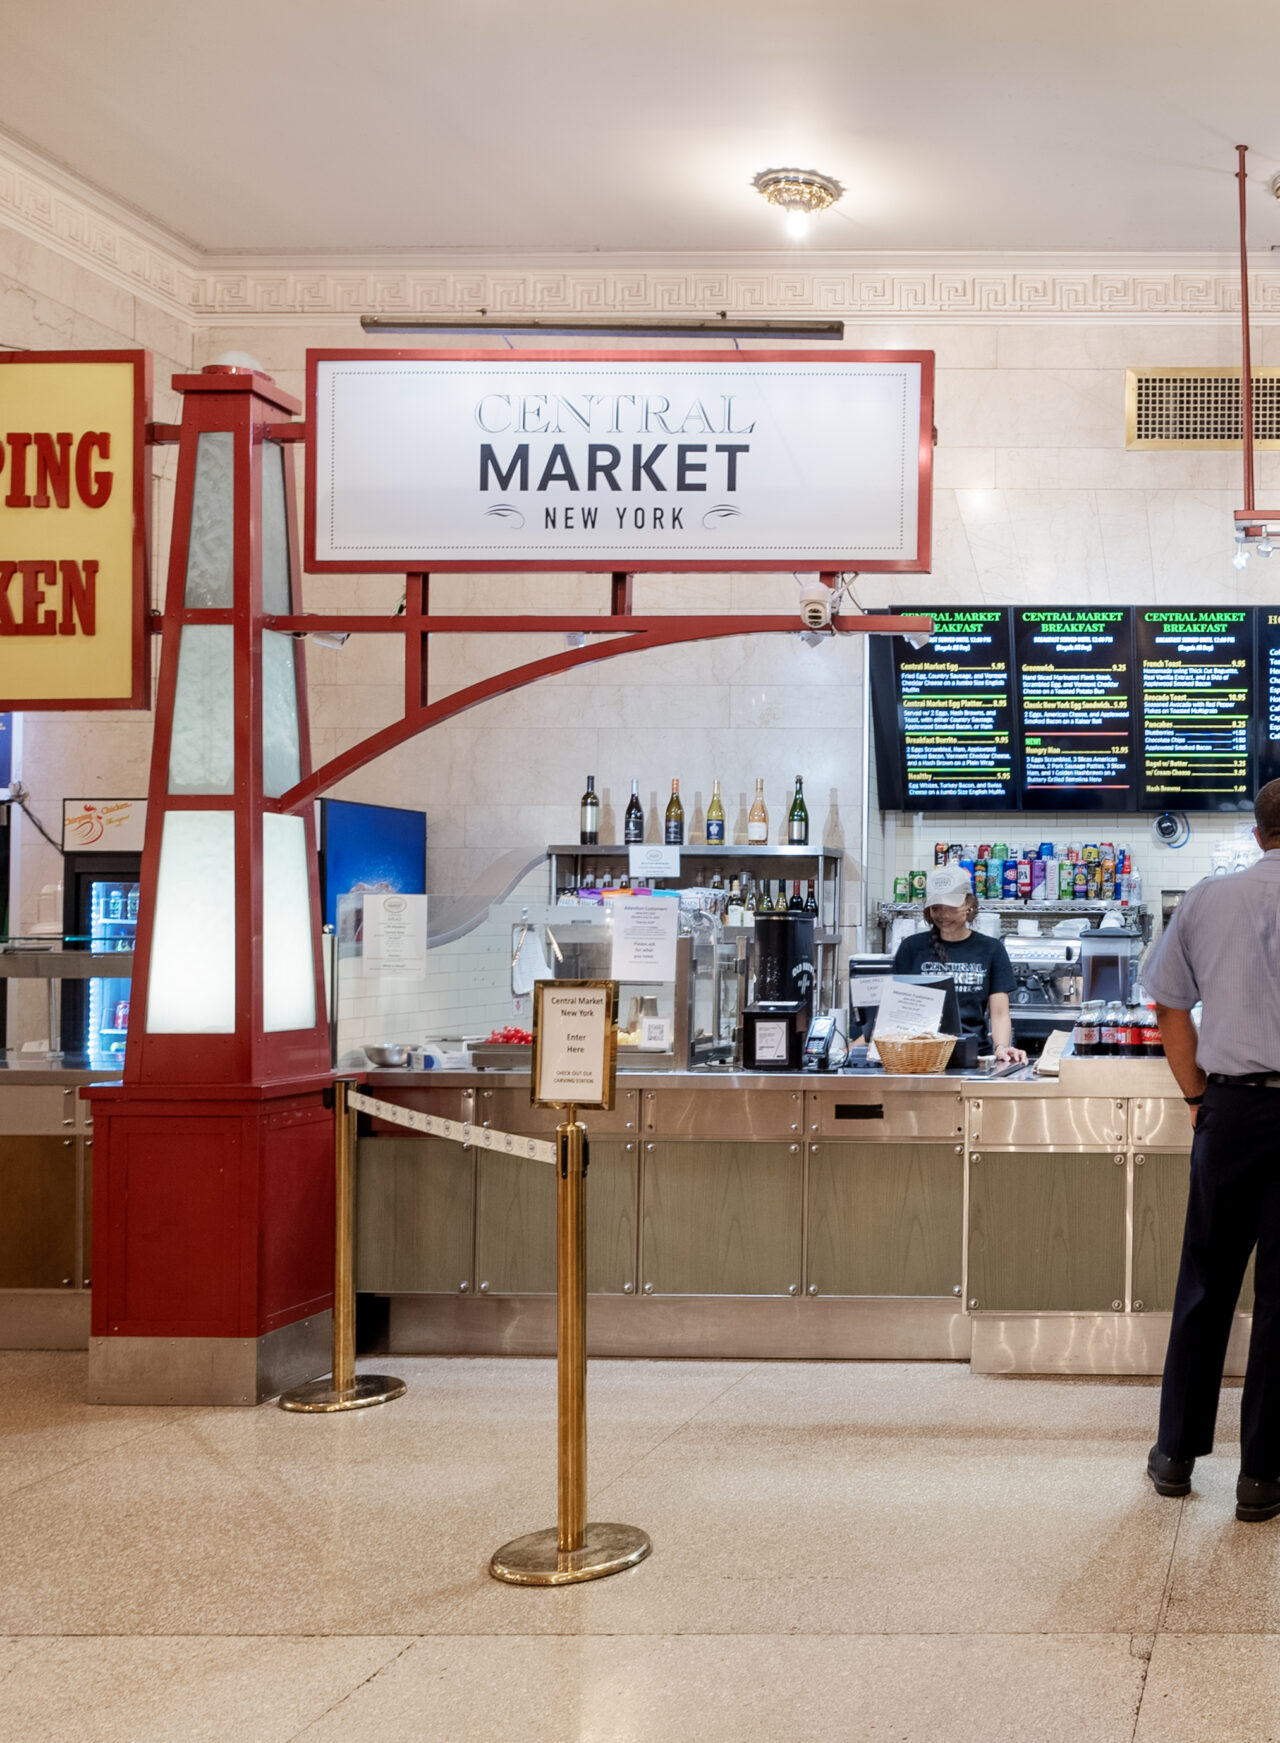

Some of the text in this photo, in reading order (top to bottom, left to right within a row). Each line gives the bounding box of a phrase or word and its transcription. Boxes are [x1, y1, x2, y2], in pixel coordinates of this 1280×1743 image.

[474, 393, 756, 435] CENTRAL
[0, 431, 114, 509] ING
[480, 443, 750, 493] MARKET
[545, 507, 685, 530] NEW YORK
[954, 612, 1001, 622] MARKET
[1022, 612, 1123, 622] CENTRAL MARKET
[1144, 612, 1246, 622] CENTRAL MARKET
[934, 624, 984, 632] EAKFAST
[1041, 624, 1105, 632] BREAKFAST
[1163, 624, 1228, 633] BREAKFAST
[948, 663, 958, 672] Egg
[921, 961, 987, 972] CENTRAL
[551, 997, 604, 1005] Central Market
[561, 1009, 594, 1017] New York
[566, 1033, 586, 1041] Enter
[567, 1046, 585, 1054] Here
